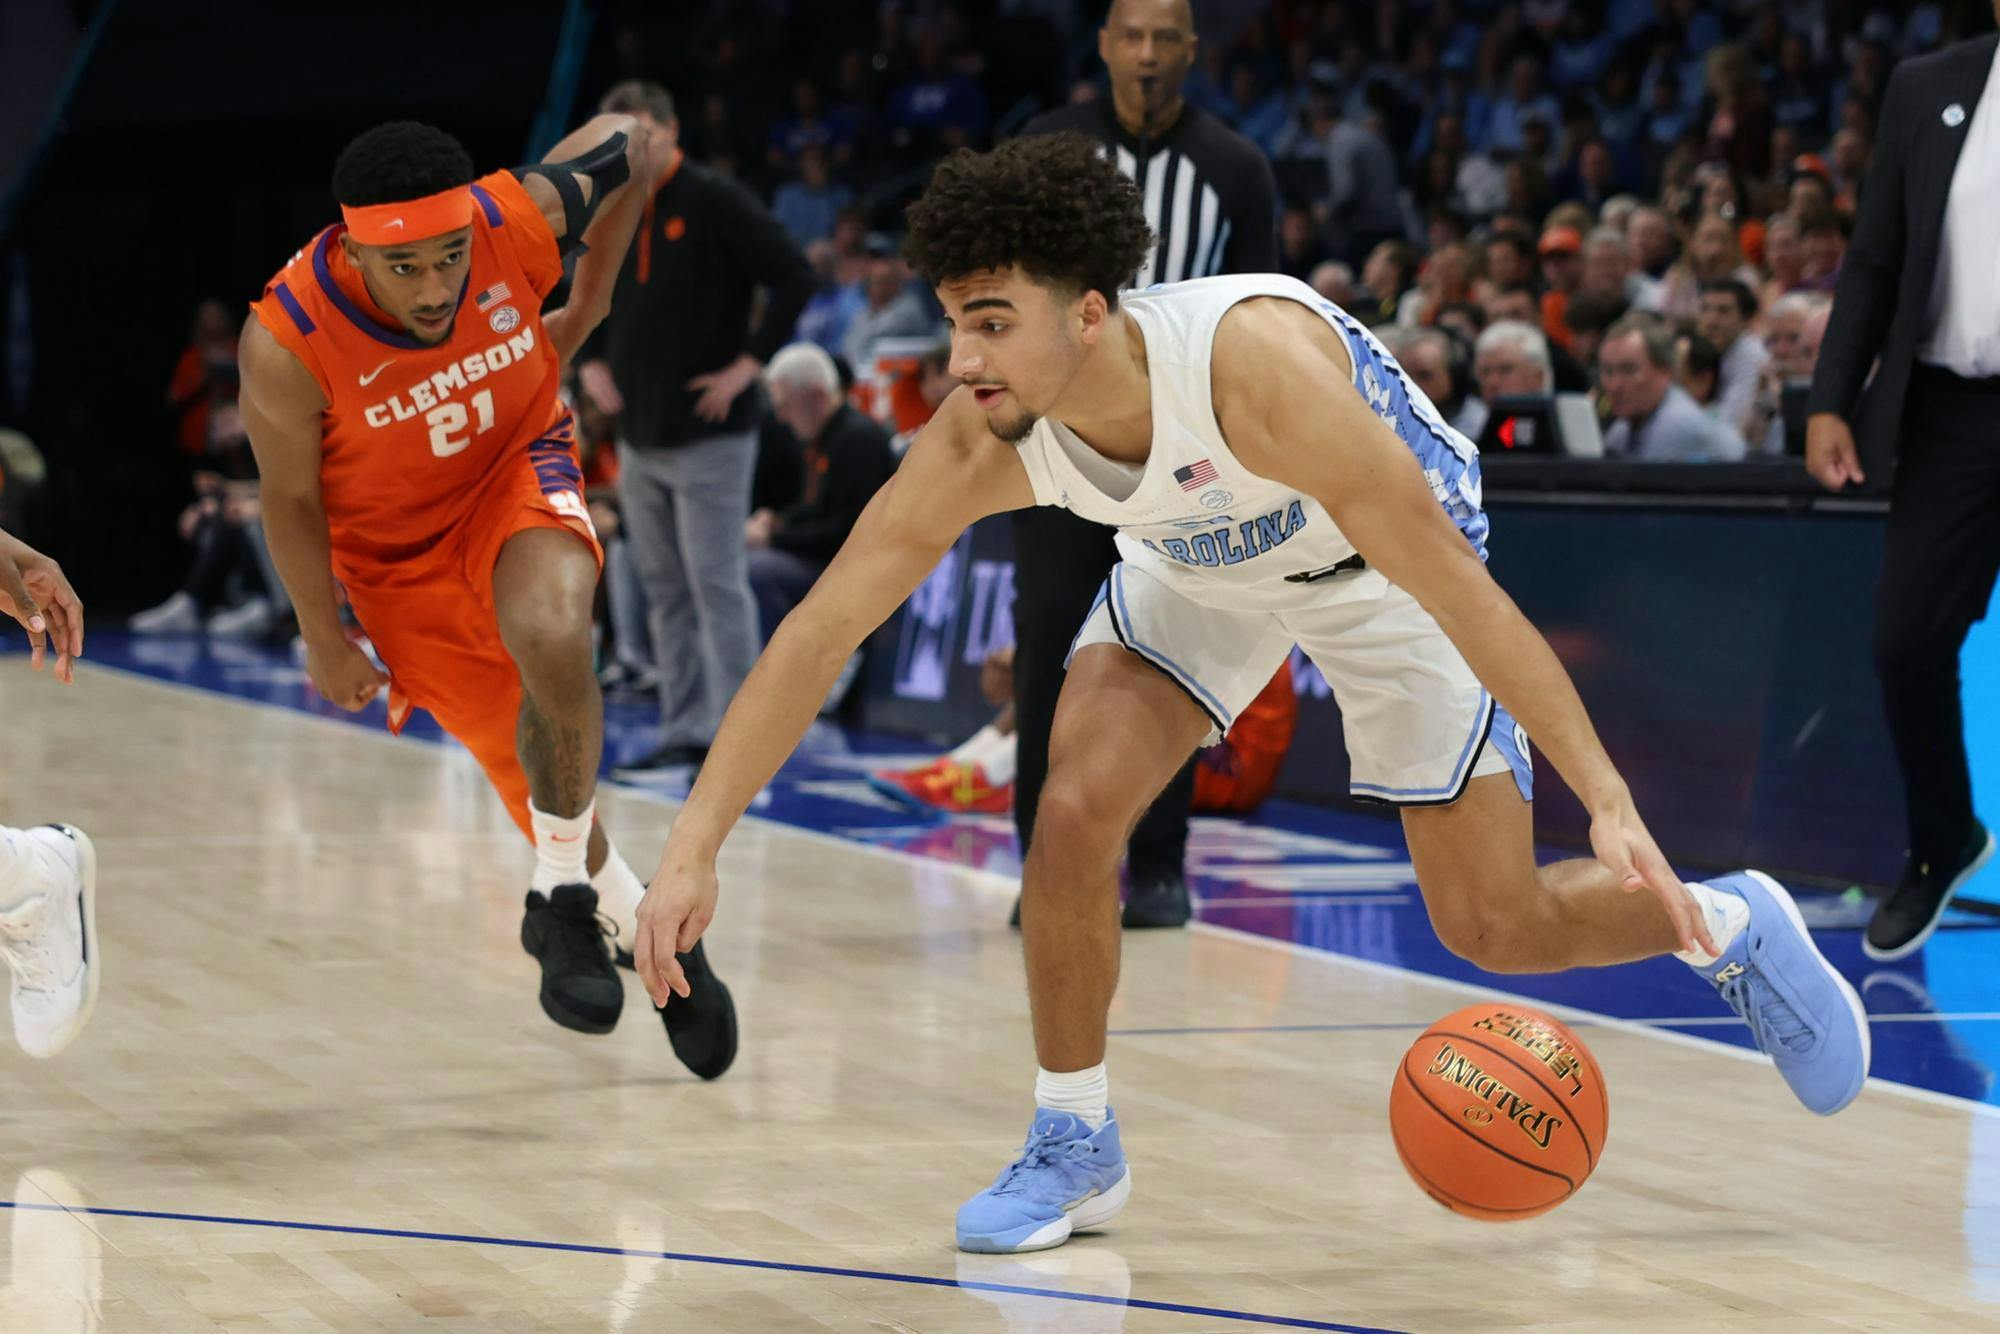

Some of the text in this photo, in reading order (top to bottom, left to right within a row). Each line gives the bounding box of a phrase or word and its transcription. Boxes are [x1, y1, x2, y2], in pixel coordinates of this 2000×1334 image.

[364, 325, 535, 429] CLEMSON
[425, 388, 495, 458] 21
[1142, 500, 1307, 568] ROLINA
[1427, 1042, 1562, 1149] SPALDING
